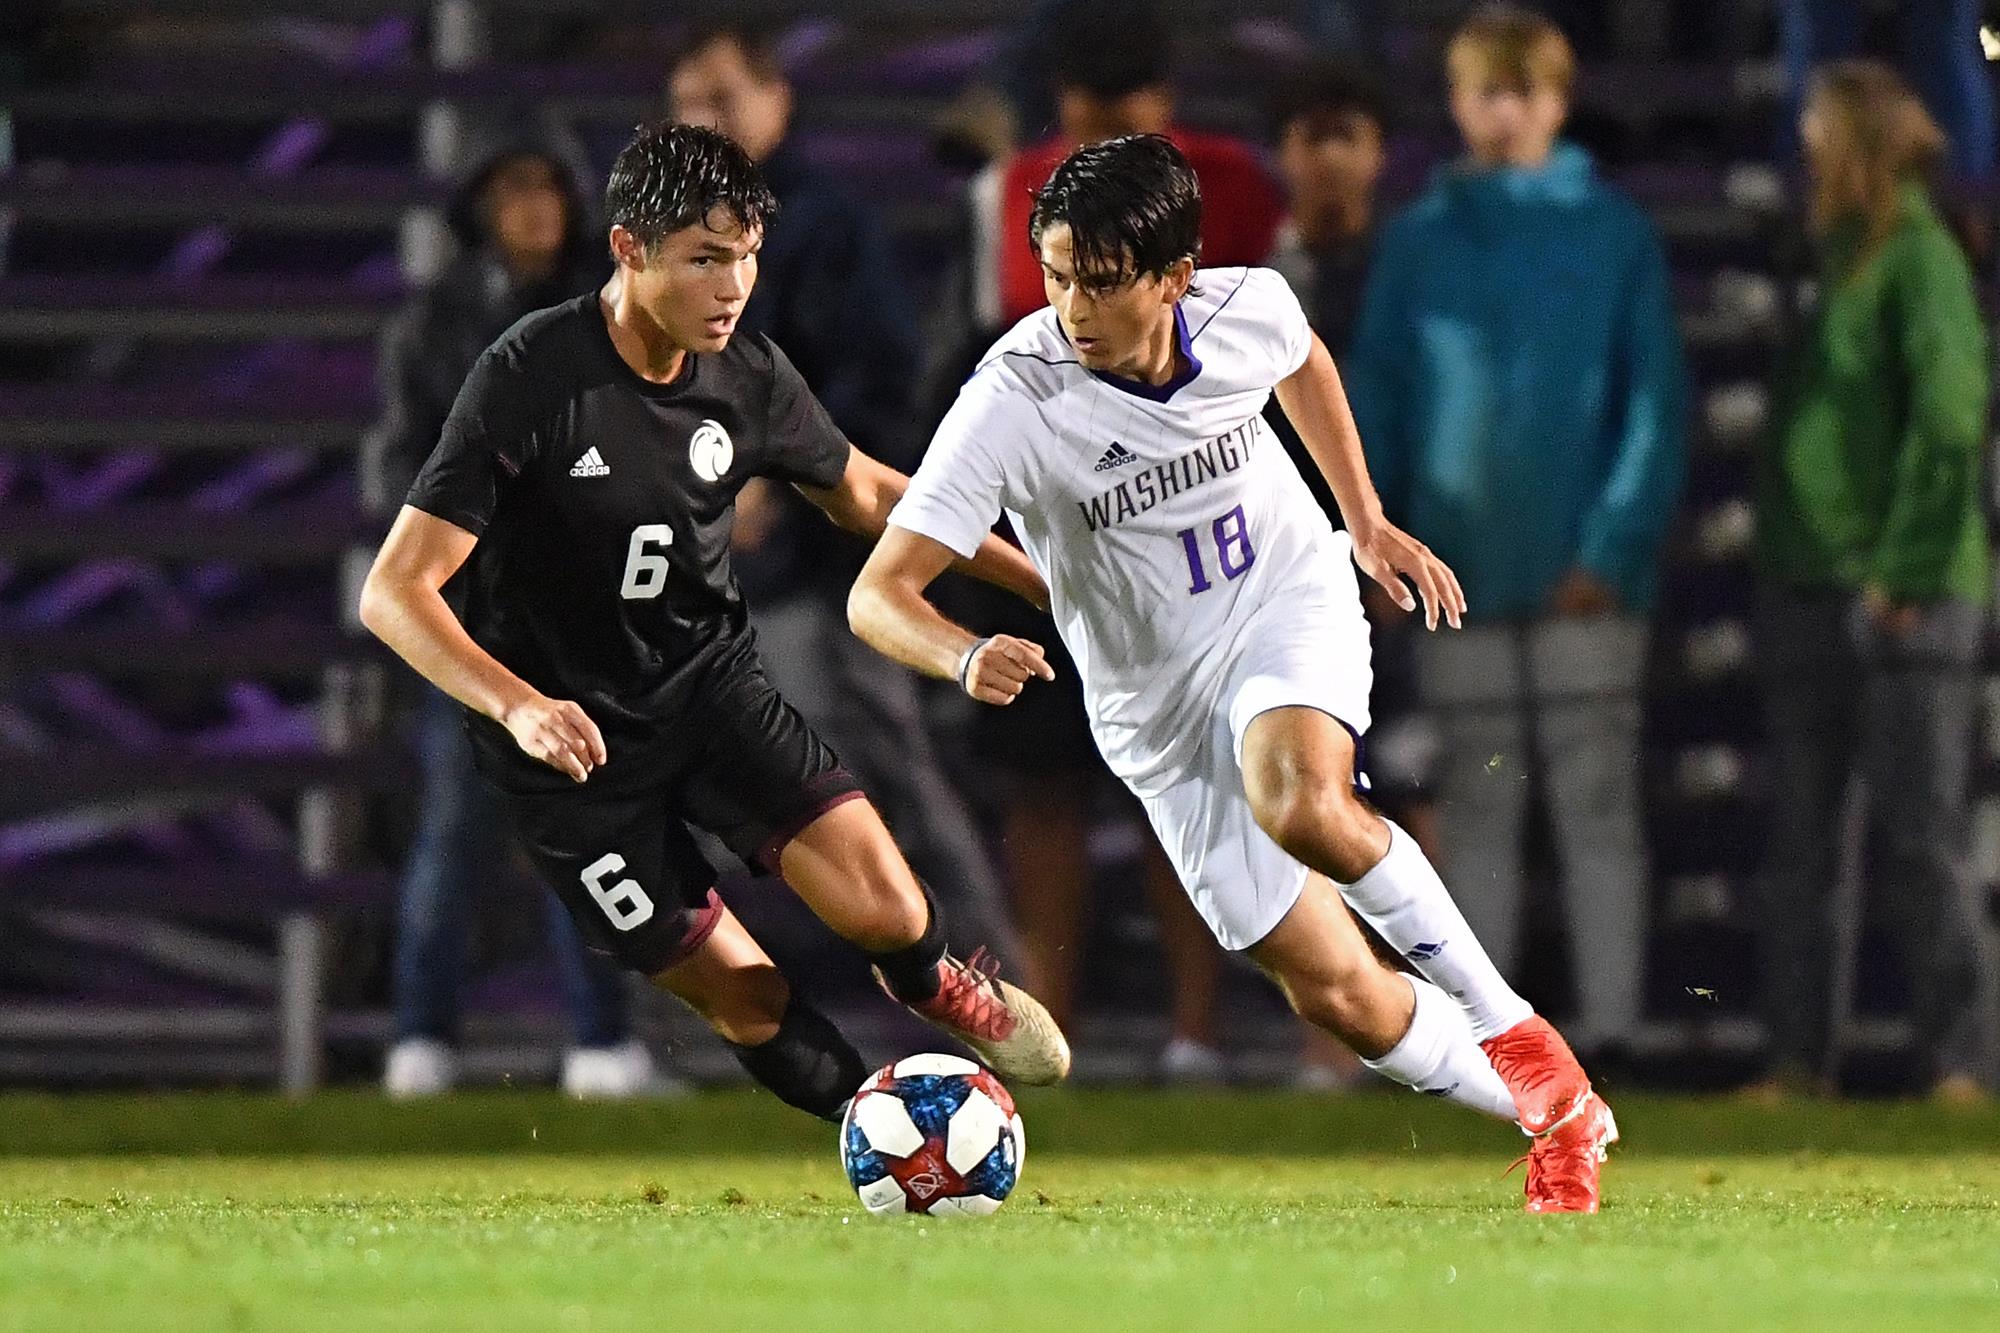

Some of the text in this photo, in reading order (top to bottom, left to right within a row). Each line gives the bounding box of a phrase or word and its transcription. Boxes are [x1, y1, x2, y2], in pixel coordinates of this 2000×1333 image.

[569, 464, 611, 477] adidas
[1094, 453, 1137, 472] adidas
[620, 523, 674, 600] 6
[1177, 503, 1256, 596] 18
[580, 852, 655, 931] 6
